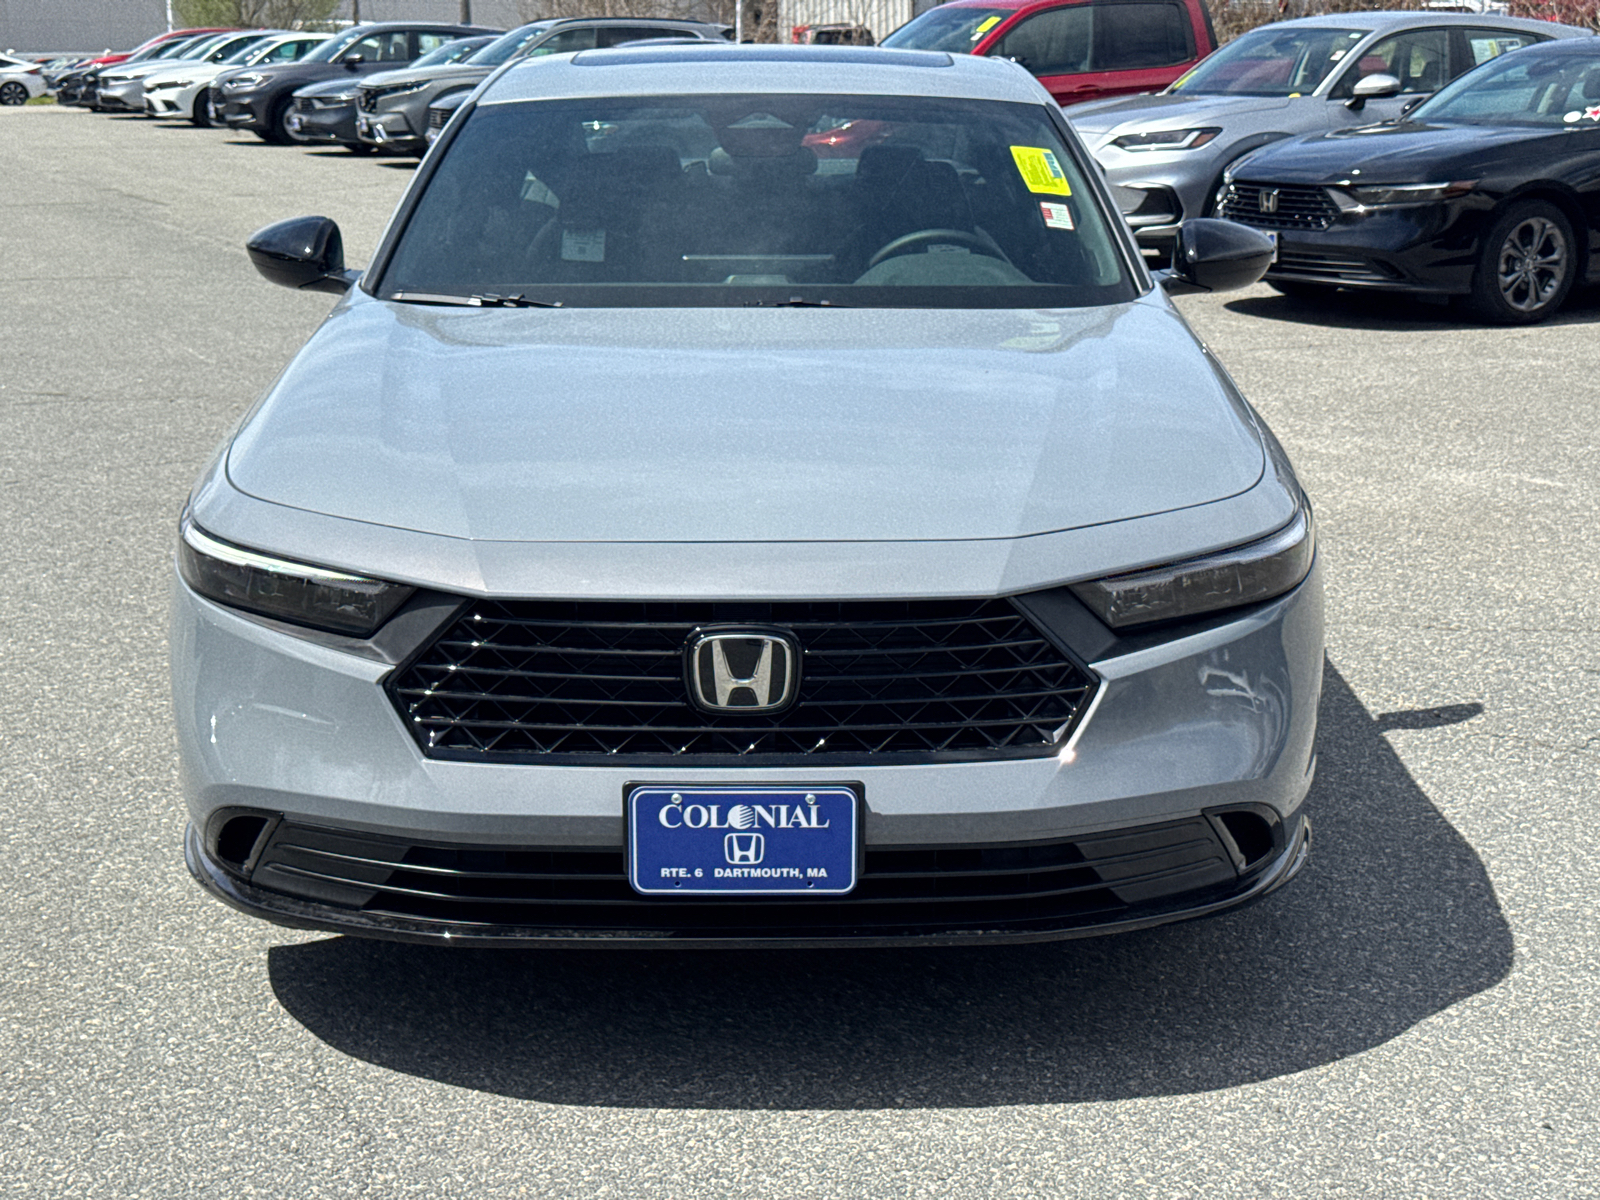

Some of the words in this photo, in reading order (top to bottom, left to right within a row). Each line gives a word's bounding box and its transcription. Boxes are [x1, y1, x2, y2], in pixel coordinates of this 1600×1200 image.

[658, 804, 830, 829] COLONIAL
[660, 868, 691, 878] RTE.
[694, 868, 703, 878] 6
[714, 868, 803, 879] DARTMOUTH,
[806, 868, 828, 878] MA
